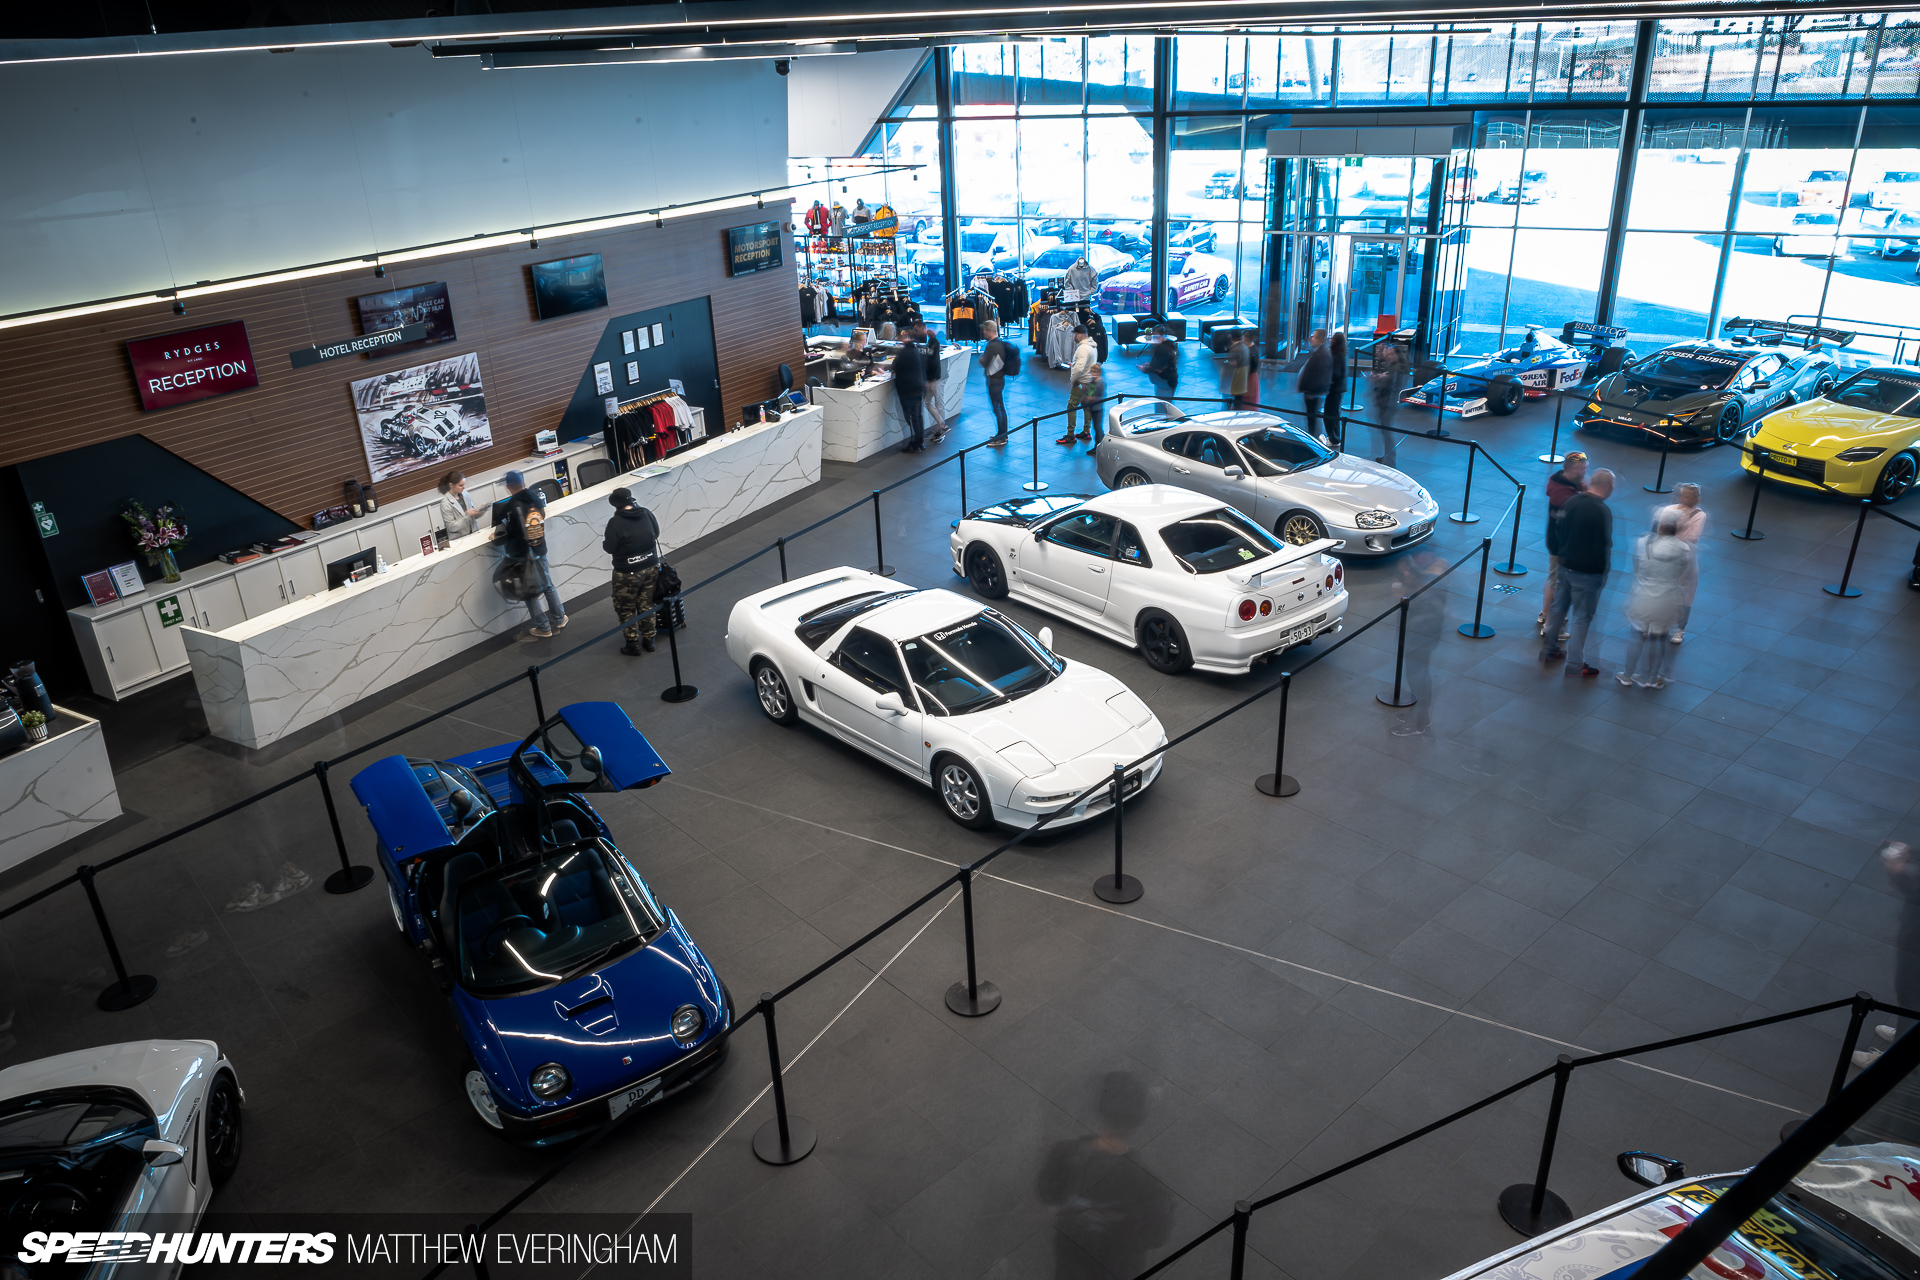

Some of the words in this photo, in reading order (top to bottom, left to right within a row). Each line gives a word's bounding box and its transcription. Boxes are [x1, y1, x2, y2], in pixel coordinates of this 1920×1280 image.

[847, 222, 873, 235] MOTORSPORT
[873, 218, 894, 230] RECEPTION
[734, 237, 779, 253] MOTORSPORT
[734, 249, 770, 263] RECEPTION
[164, 341, 220, 360] RYDGES
[319, 344, 351, 359] HOTEL
[351, 331, 402, 352] RECEPTION
[1660, 350, 1694, 358] ROGER
[1695, 355, 1739, 366] DUBUIS
[148, 359, 247, 393] RECEPTION
[1532, 379, 1547, 387] AIR
[1559, 368, 1584, 384] FedEx
[944, 626, 963, 637] Formula
[962, 621, 978, 630] Honda
